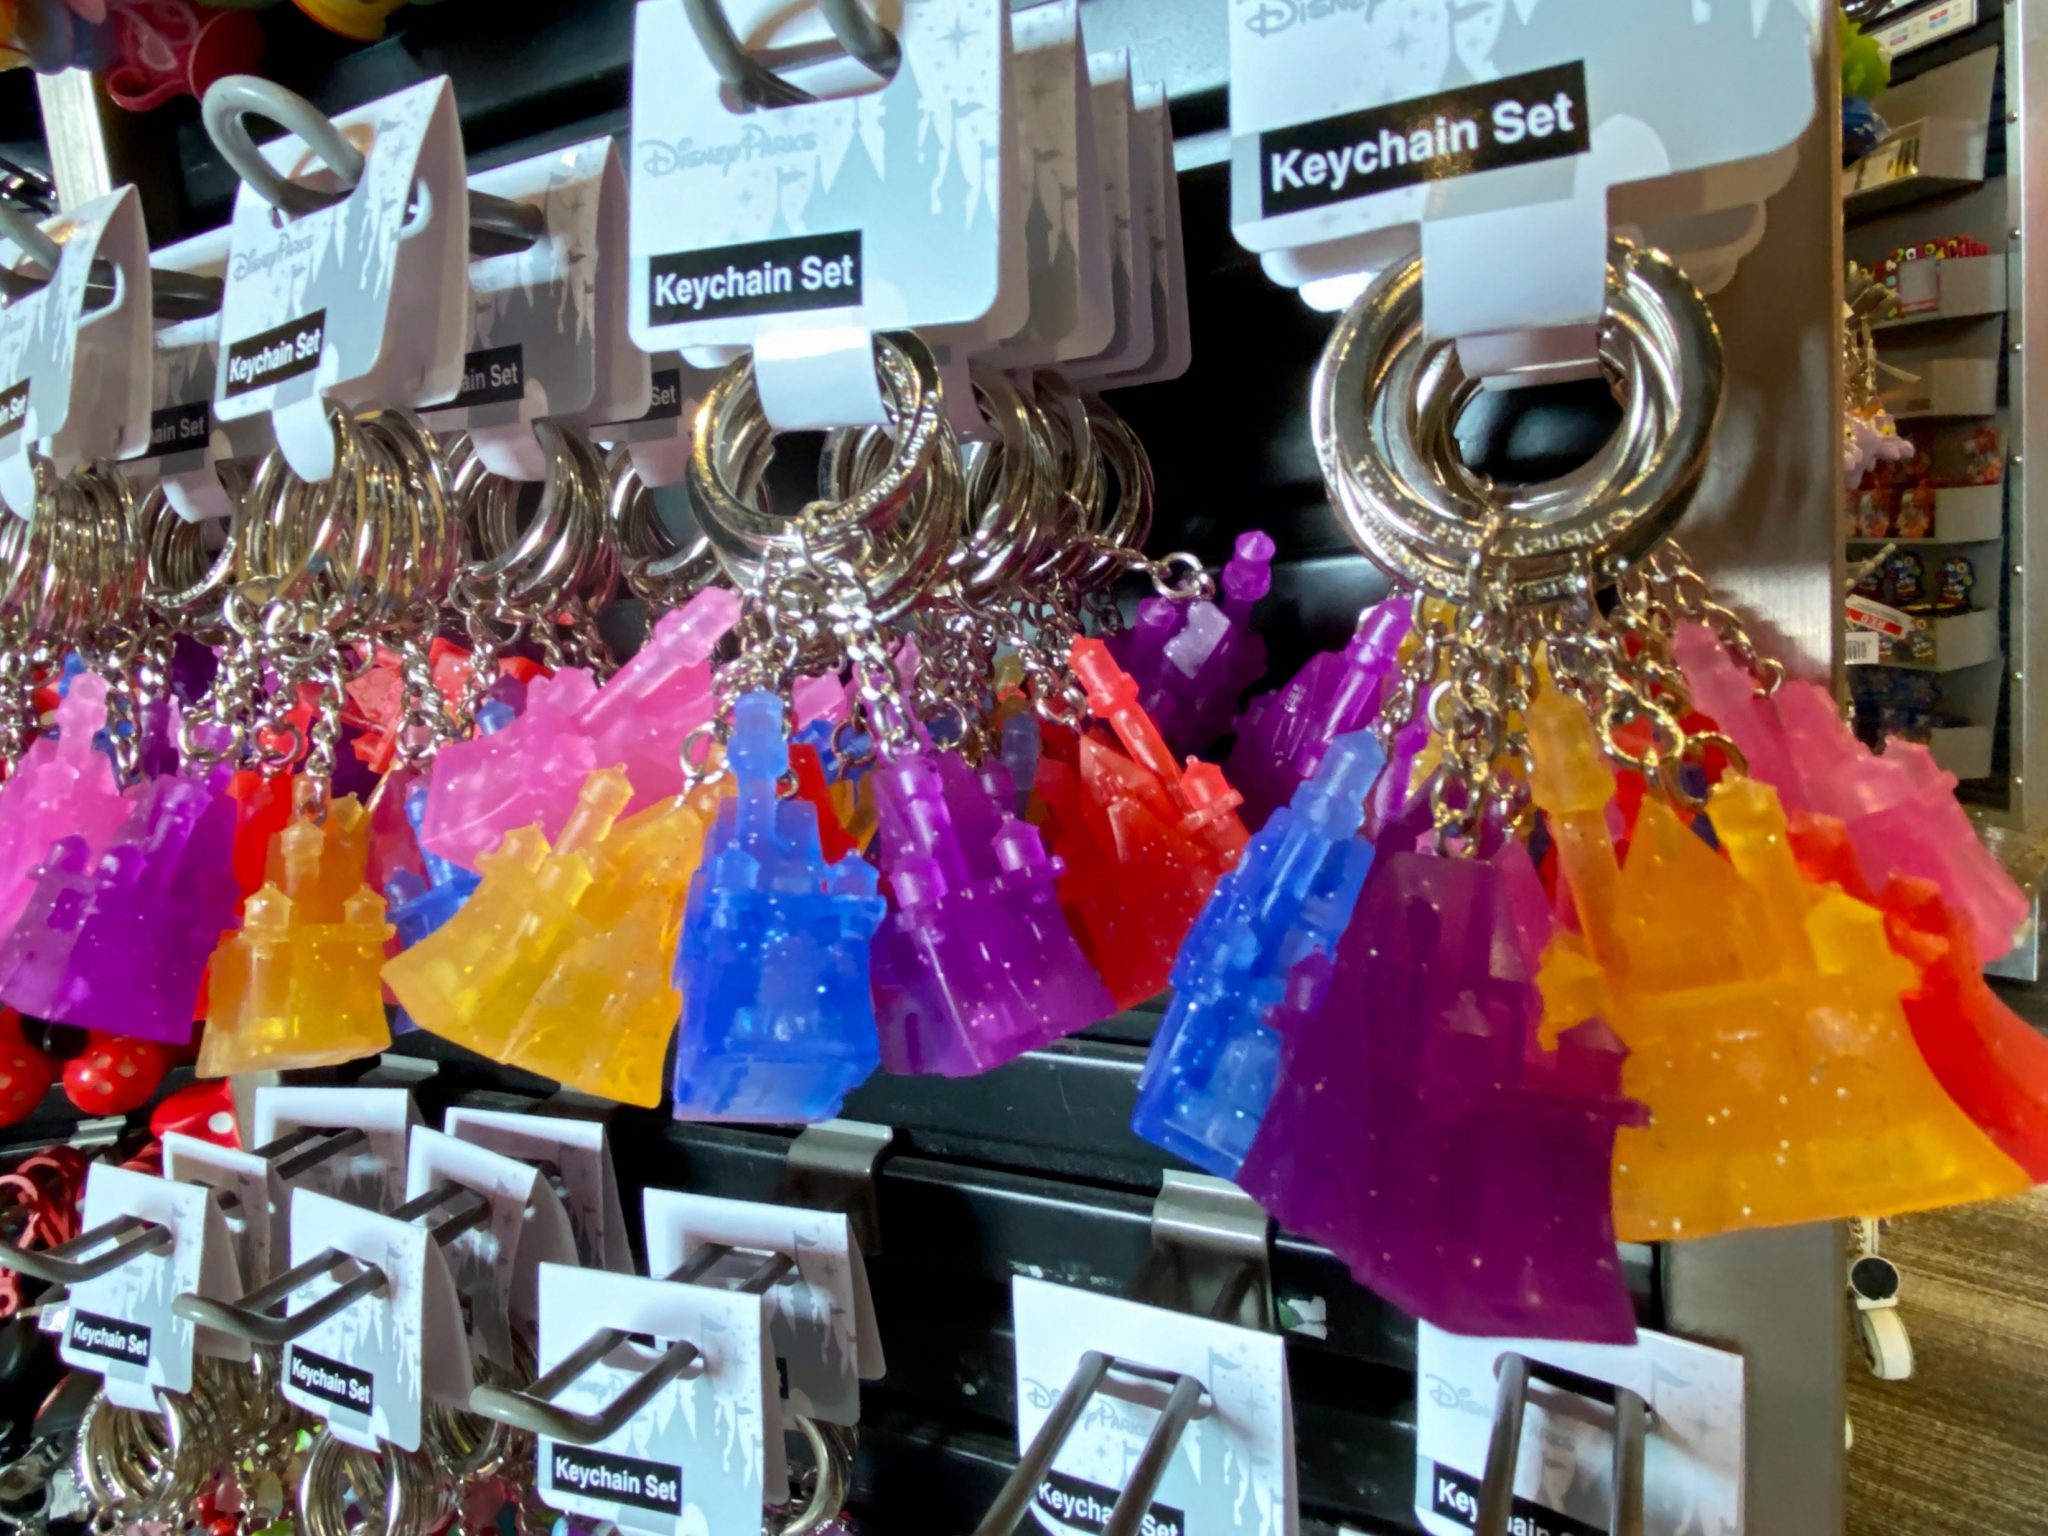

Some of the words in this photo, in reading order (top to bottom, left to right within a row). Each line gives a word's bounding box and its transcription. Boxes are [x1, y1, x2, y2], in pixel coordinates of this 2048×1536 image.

[1271, 116, 1480, 192] Keychain
[1491, 91, 1576, 145] Set
[654, 261, 793, 311] Keychain
[800, 254, 855, 291] Set
[229, 340, 294, 384] Keychain
[295, 328, 322, 359] Set
[489, 362, 519, 388] Set
[650, 384, 677, 406] Set
[72, 1320, 126, 1352] Keychain
[127, 1333, 149, 1357] Set
[291, 1356, 348, 1394] Keychain
[348, 1379, 371, 1405] Set
[555, 1456, 641, 1494] Keychain
[644, 1474, 678, 1503] Set
[1038, 1481, 1114, 1525] Keycha
